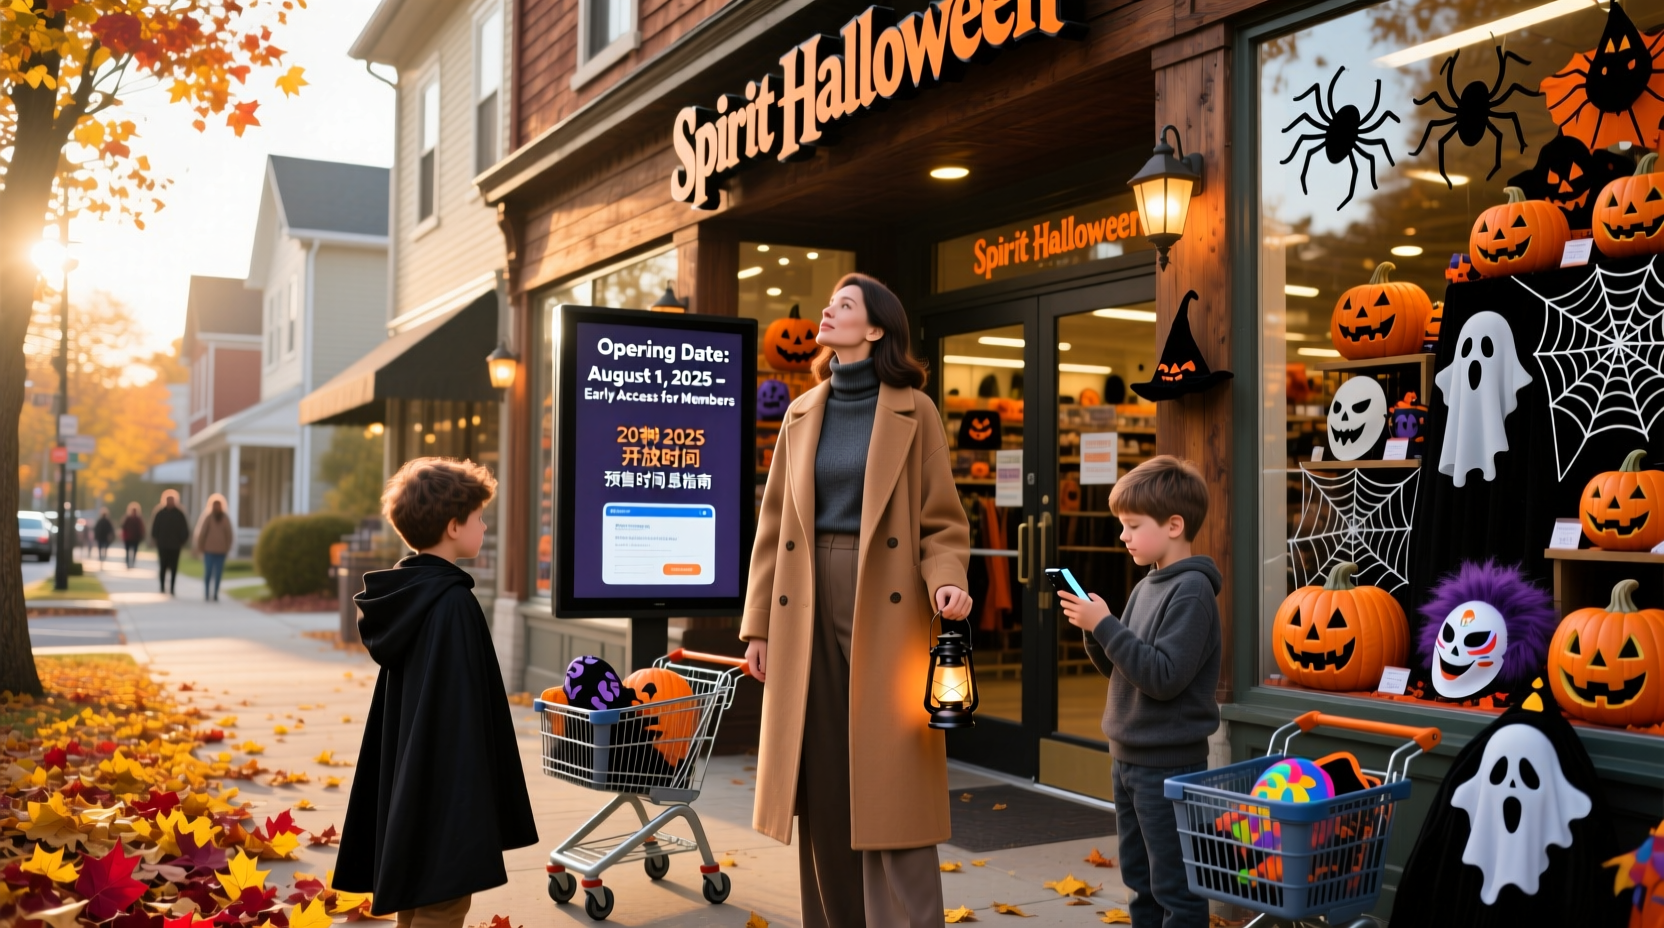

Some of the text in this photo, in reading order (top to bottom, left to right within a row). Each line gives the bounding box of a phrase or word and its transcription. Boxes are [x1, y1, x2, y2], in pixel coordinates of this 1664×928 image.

[670, 73, 775, 210] Spirit
[973, 230, 1029, 280] Spirit
[681, 343, 730, 363] Date:
[587, 365, 651, 387] August
[655, 369, 668, 388] 1,
[671, 370, 712, 387] 2025
[584, 387, 736, 406] Early Access for Members
[662, 428, 706, 446] 2025
